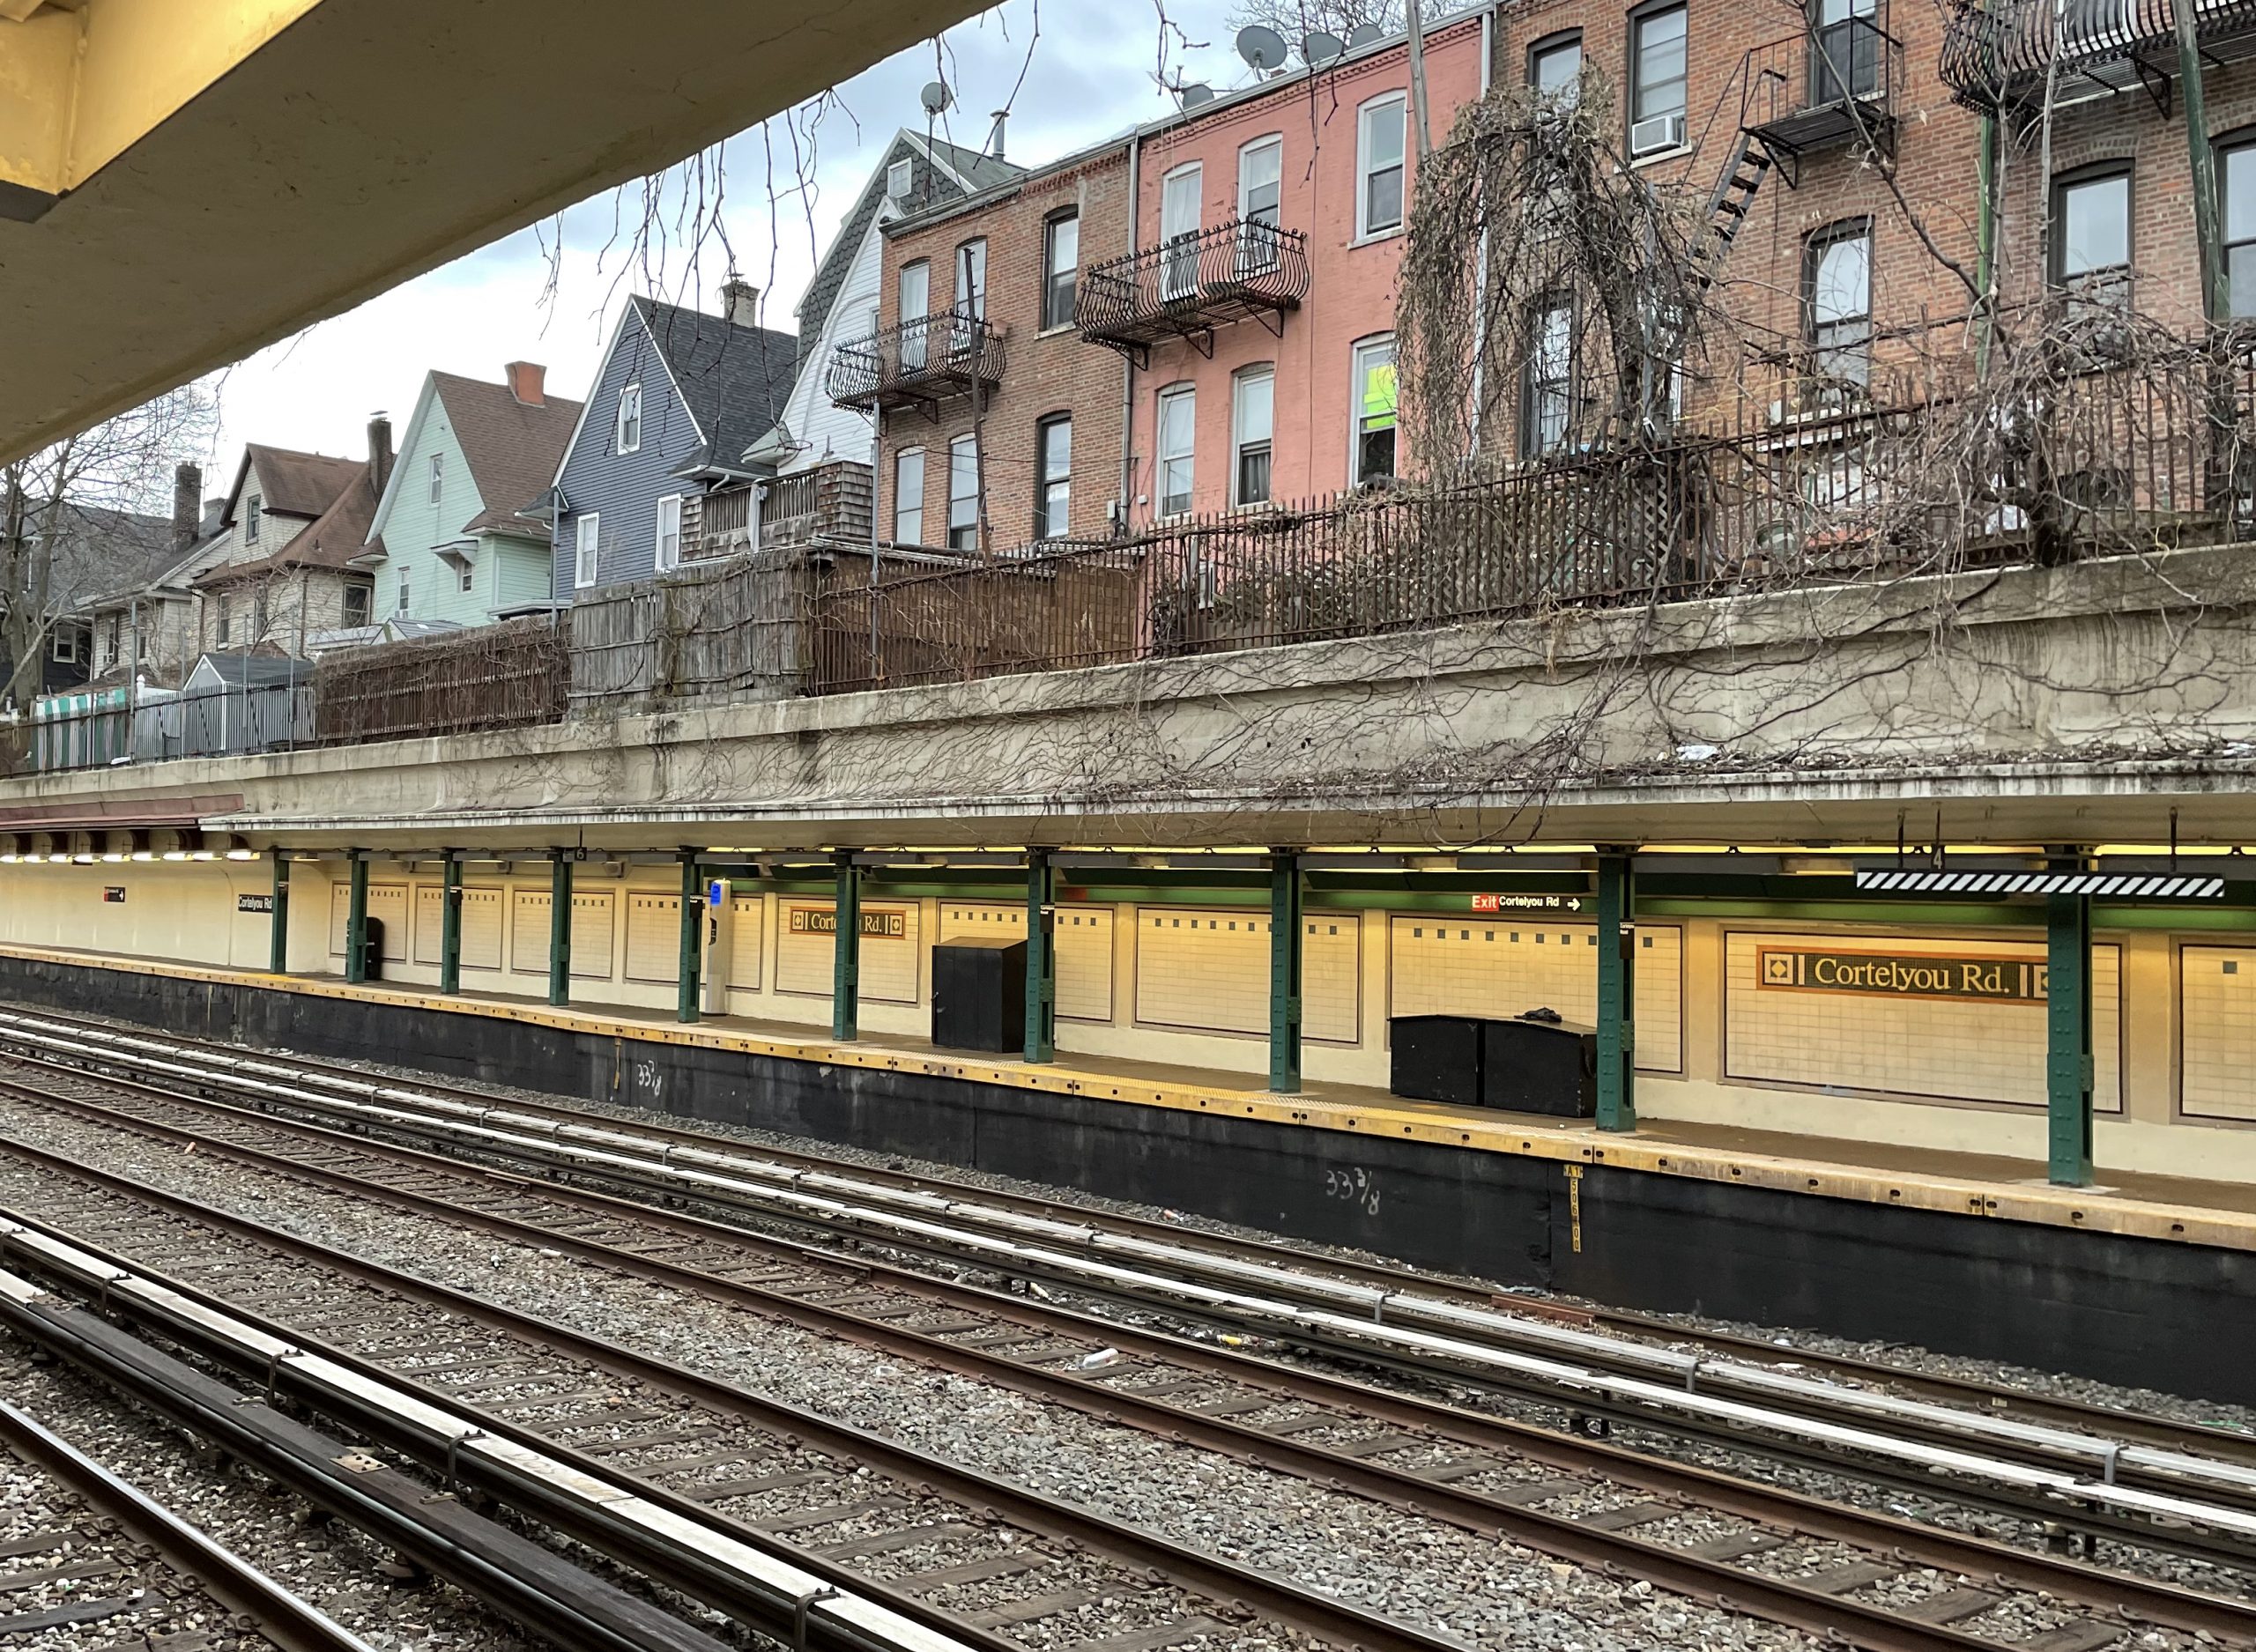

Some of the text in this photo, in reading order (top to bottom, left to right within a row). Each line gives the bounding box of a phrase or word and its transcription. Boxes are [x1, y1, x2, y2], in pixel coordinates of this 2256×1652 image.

[576, 848, 584, 860] 6
[1933, 848, 1942, 870] 4
[1472, 895, 1559, 908] Exit Cortelyou Rd
[865, 915, 882, 933] Rd.
[1814, 958, 2010, 994] Cortelyou Rd.
